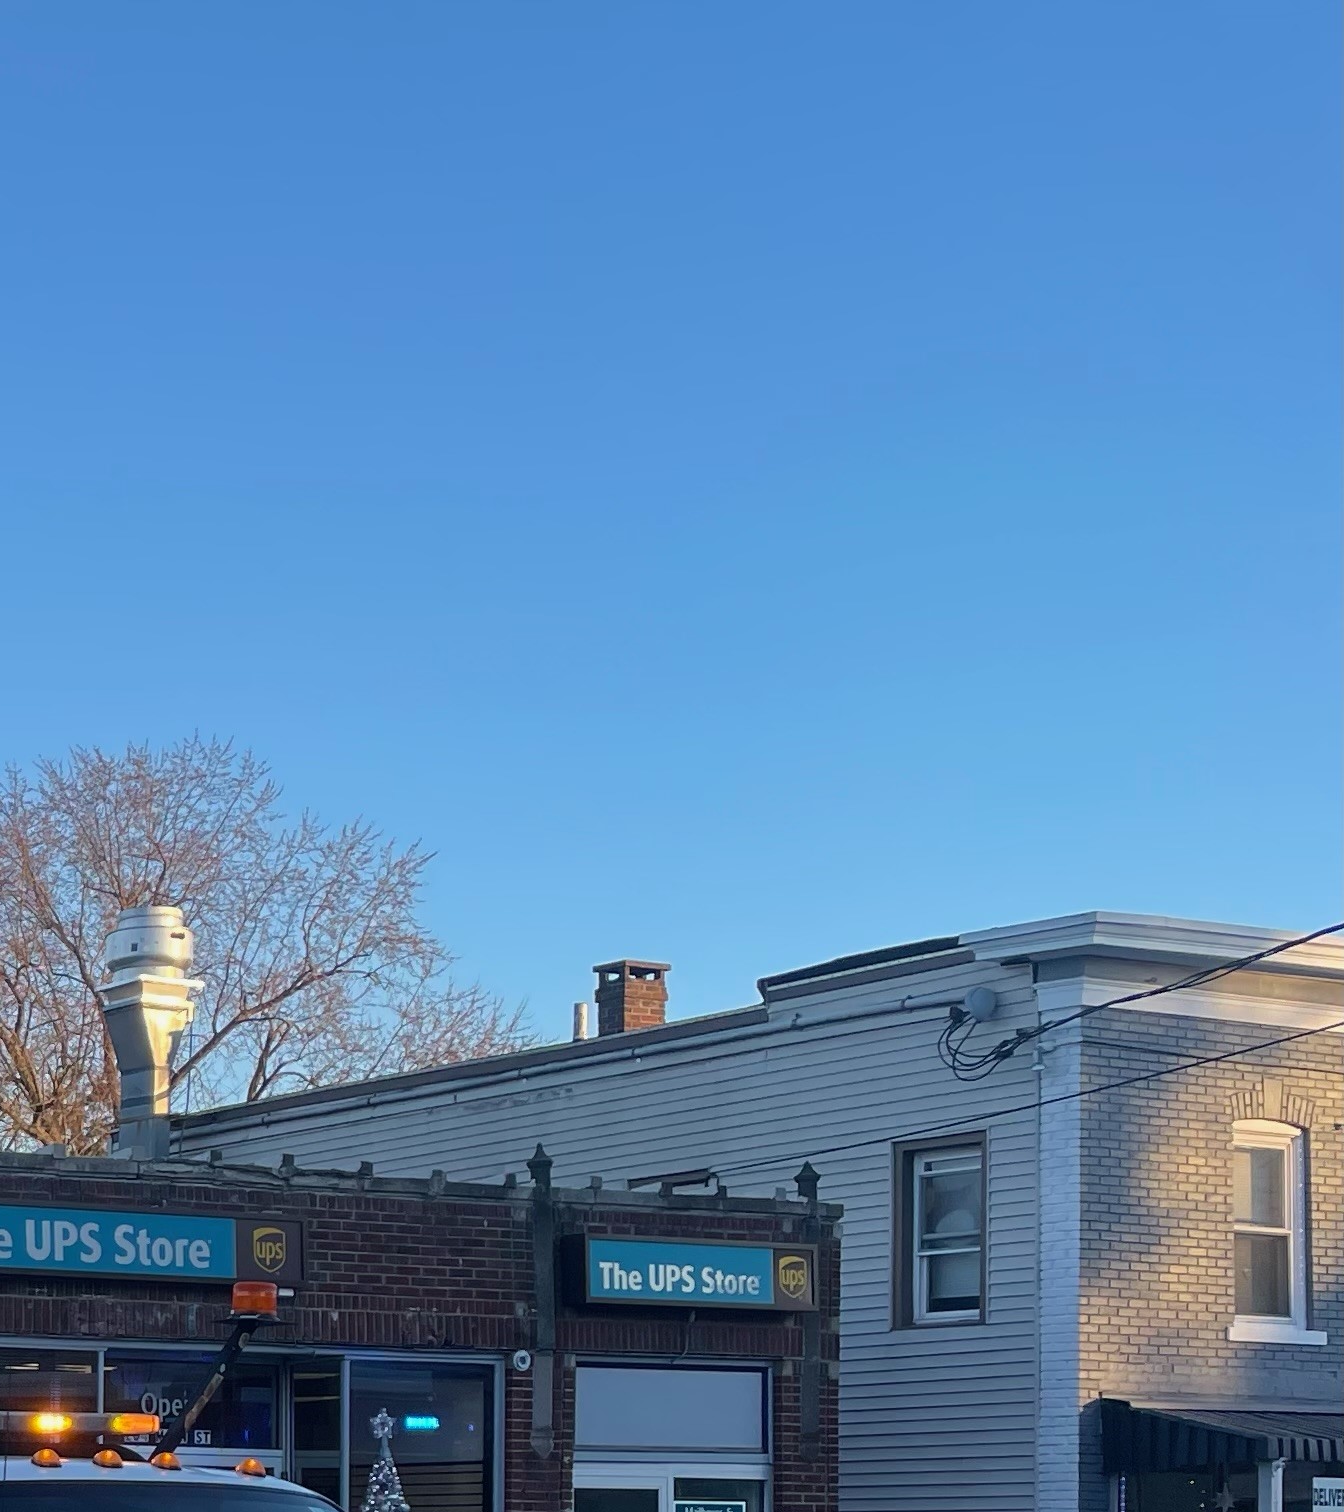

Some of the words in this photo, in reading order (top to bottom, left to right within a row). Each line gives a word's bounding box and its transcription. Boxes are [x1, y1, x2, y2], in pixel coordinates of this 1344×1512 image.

[25, 1219, 102, 1263] UPS
[114, 1224, 212, 1269] Store
[255, 1238, 284, 1260] ups
[599, 1261, 642, 1291] The
[649, 1263, 695, 1294] UPS
[701, 1266, 760, 1295] Store
[781, 1268, 806, 1293] ups
[141, 1392, 189, 1422] Ope
